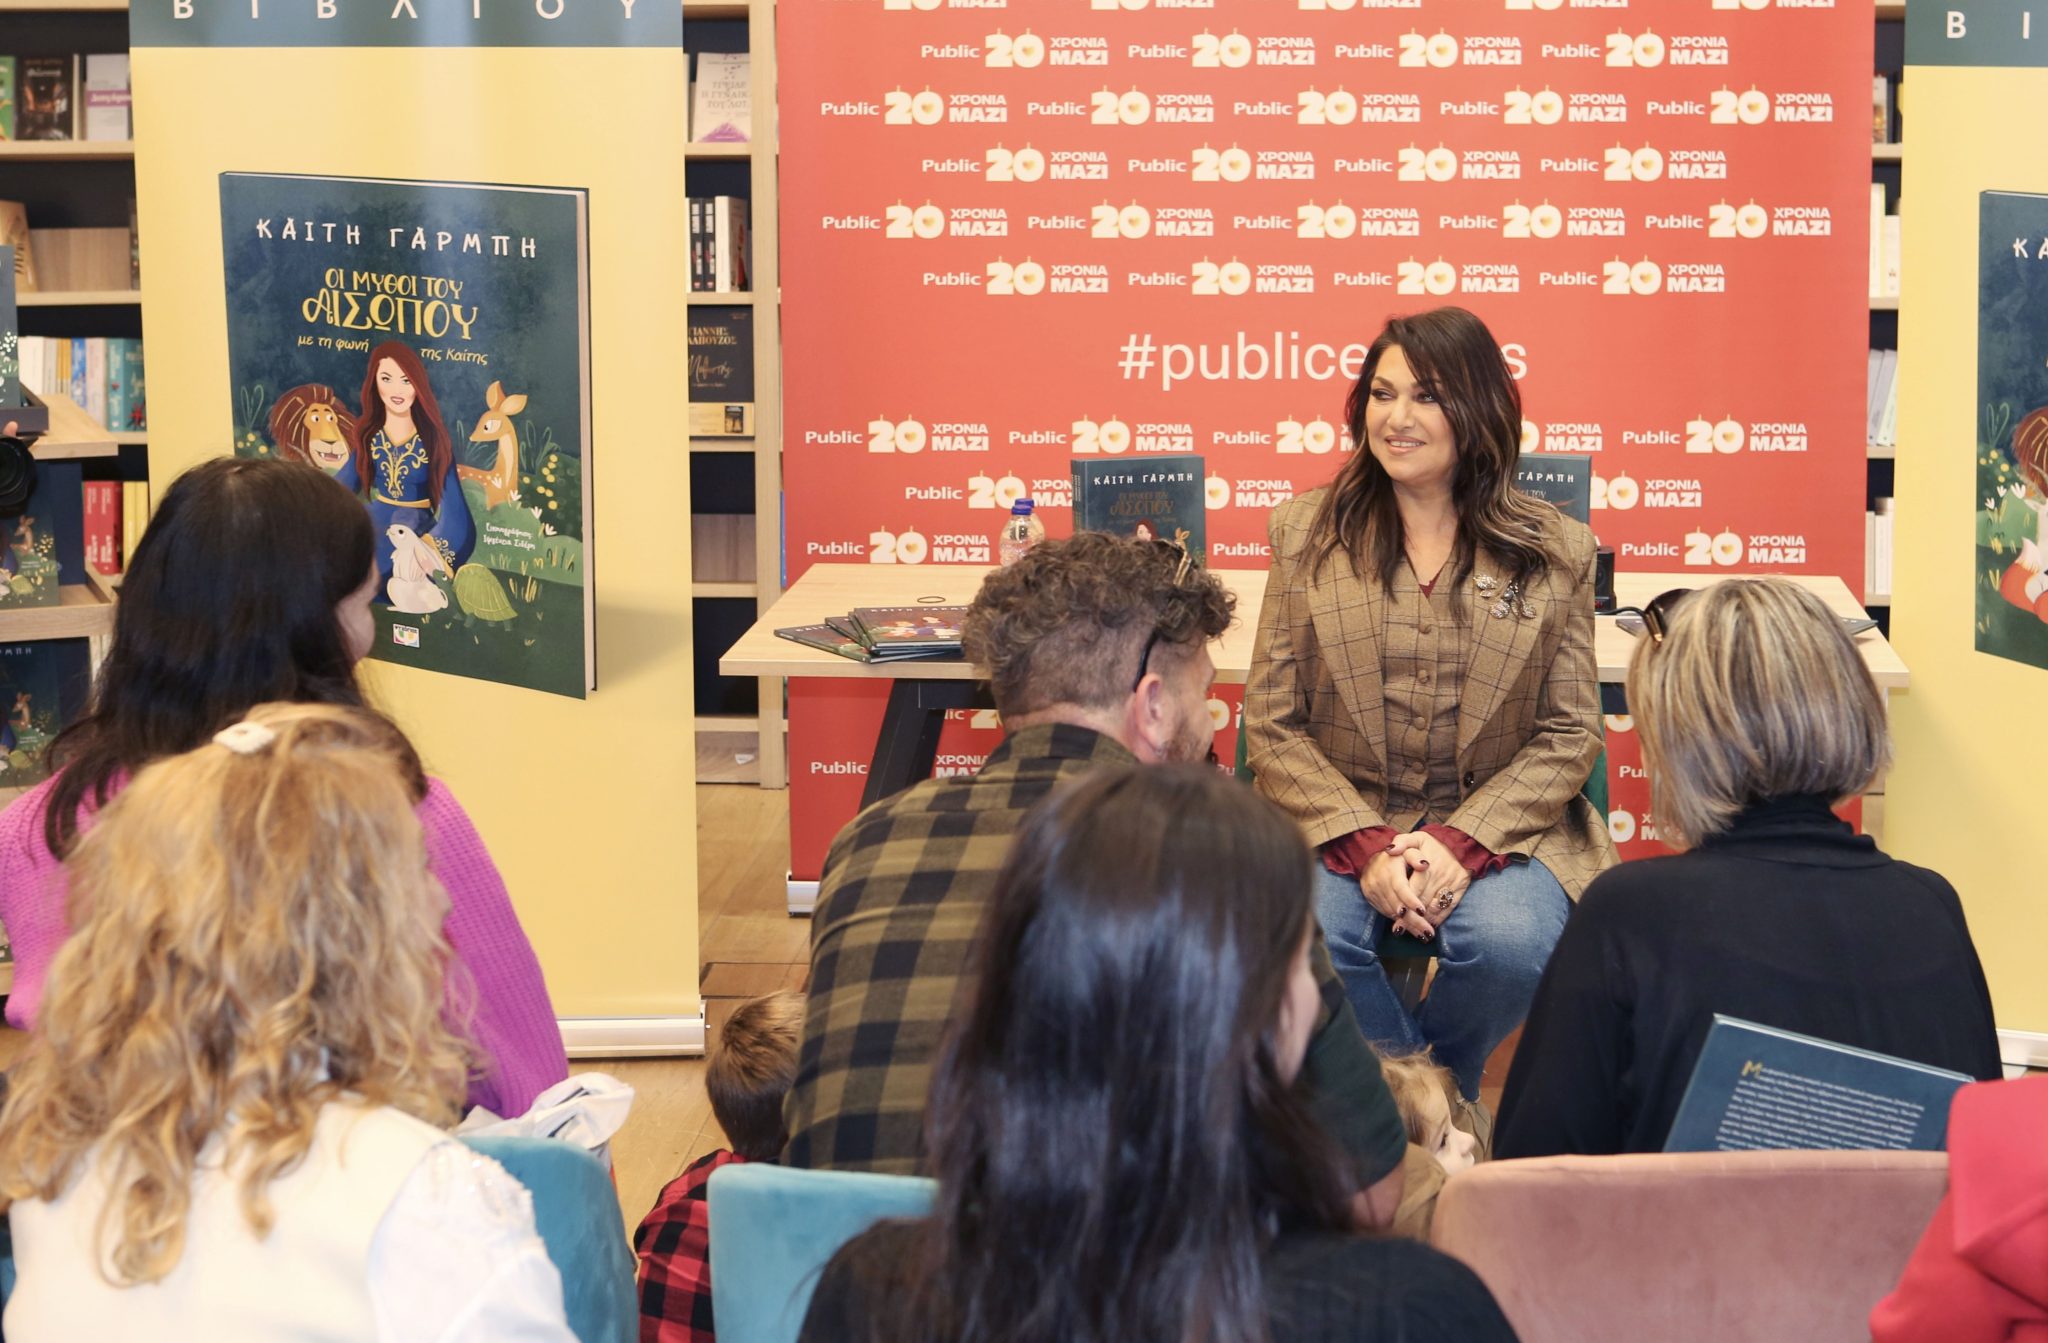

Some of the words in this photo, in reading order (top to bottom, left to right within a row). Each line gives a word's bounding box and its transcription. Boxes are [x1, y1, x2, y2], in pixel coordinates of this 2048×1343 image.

[1050, 37, 1109, 49] ΧΡΟΝΙΑ
[1256, 36, 1316, 48] ΧΡΟΝΙΑ
[1464, 36, 1522, 49] ΧΡΟΝΙΑ
[1671, 37, 1729, 49] ΧΡΟΝΙΑ
[921, 45, 979, 58] Public
[984, 33, 1045, 68] 20
[1049, 50, 1109, 65] ΜΑΖΙ
[1128, 44, 1186, 59] Public
[1192, 33, 1252, 68] 20
[1256, 50, 1315, 65] ΜΑΖΙ
[1335, 44, 1393, 58] Public
[1399, 33, 1459, 68] 20
[1463, 50, 1522, 65] ΜΑΖΙ
[1542, 44, 1600, 58] Public
[1605, 33, 1665, 67] 20
[1670, 50, 1728, 64] ΜΑΖΙ
[949, 95, 1008, 105] ΧΡΟΝΙΑ
[1156, 94, 1215, 106] ΧΡΟΝΙΑ
[1362, 94, 1421, 106] ΧΡΟΝΙΑ
[1568, 93, 1627, 105] ΧΡΟΝΙΑ
[1775, 94, 1833, 104] ΧΡΟΝΙΑ
[821, 102, 879, 115] Public
[885, 90, 944, 125] 20
[1027, 101, 1085, 115] Public
[1091, 90, 1151, 125] 20
[1155, 107, 1215, 122] ΜΑΖΙ
[1234, 101, 1292, 115] Public
[1297, 90, 1358, 125] 20
[1362, 107, 1421, 122] ΜΑΖΙ
[1440, 101, 1498, 115] Public
[1504, 90, 1564, 125] 20
[1568, 107, 1627, 122] ΜΑΖΙ
[1647, 101, 1704, 115] Public
[1710, 90, 1770, 124] 20
[1775, 107, 1833, 122] ΜΑΖΙ
[949, 107, 1008, 123] ΜΑΖΙ
[922, 159, 980, 172] Public
[986, 148, 1045, 182] 20
[1050, 151, 1108, 164] ΧΡΟΝΙΑ
[1128, 159, 1186, 172] Public
[1191, 148, 1252, 182] 20
[1256, 151, 1315, 164] ΧΡΟΝΙΑ
[1334, 159, 1392, 172] Public
[1397, 148, 1458, 182] 20
[1463, 151, 1521, 164] ΧΡΟΝΙΑ
[1540, 159, 1598, 172] Public
[1604, 148, 1663, 181] 20
[1669, 151, 1726, 164] ΧΡΟΝΙΑ
[1050, 164, 1109, 179] ΜΑΖΙ
[1256, 164, 1315, 179] ΜΑΖΙ
[1462, 164, 1521, 179] ΜΑΖΙ
[1668, 164, 1726, 179] ΜΑΖΙ
[950, 208, 1008, 220] ΧΡΟΝΙΑ
[1155, 208, 1215, 219] ΧΡΟΝΙΑ
[1361, 208, 1420, 219] ΧΡΟΝΙΑ
[1440, 215, 1497, 228] Public
[1503, 204, 1562, 238] 20
[1568, 208, 1625, 220] ΧΡΟΝΙΑ
[1645, 215, 1702, 228] Public
[1708, 204, 1768, 238] 20
[1774, 208, 1831, 220] ΧΡΟΝΙΑ
[823, 216, 880, 228] Public
[886, 204, 945, 239] 20
[950, 221, 1008, 236] ΜΑΖΙ
[1028, 216, 1085, 229] Public
[1091, 204, 1151, 239] 20
[1155, 221, 1214, 236] ΜΑΖΙ
[1234, 216, 1291, 229] Public
[1297, 204, 1357, 239] 20
[1361, 221, 1420, 237] ΜΑΖΙ
[1567, 221, 1625, 236] ΜΑΖΙ
[1773, 221, 1831, 235] ΜΑΖΙ
[256, 217, 361, 245] ΚΑΙΤΗ
[389, 226, 537, 259] ΓΑΡΜΠΗ
[923, 272, 980, 285] Public
[986, 261, 1046, 295] 20
[1050, 265, 1109, 276] ΧΡΟΝΙΑ
[1256, 265, 1314, 277] ΧΡΟΝΙΑ
[1461, 265, 1520, 277] ΧΡΟΝΙΑ
[1539, 272, 1597, 285] Public
[1603, 261, 1662, 295] 20
[1668, 264, 1725, 277] ΧΡΟΝΙΑ
[325, 267, 345, 289] ΟΙ
[352, 271, 418, 297] ΜΥΘΟΙ
[421, 276, 463, 300] ΤΟΥ
[1050, 278, 1109, 293] ΜΑΖΙ
[1128, 272, 1185, 285] Public
[1192, 261, 1252, 296] 20
[1256, 278, 1314, 293] ΜΑΖΙ
[1334, 272, 1392, 286] Public
[1397, 261, 1457, 296] 20
[1461, 278, 1520, 292] ΜΑΖΙ
[1667, 278, 1725, 292] ΜΑΖΙ
[302, 287, 479, 340] ΑΙΣΩΠΟΥ
[1118, 332, 1527, 391] #publices
[806, 431, 861, 443] Public
[868, 420, 926, 453] 20
[932, 424, 989, 434] ΧΡΟΝΙΑ
[1009, 431, 1065, 444] Public
[1072, 420, 1130, 453] 20
[1135, 424, 1193, 434] ΧΡΟΝΙΑ
[1545, 424, 1602, 434] ΧΡΟΝΙΑ
[1623, 431, 1680, 444] Public
[1686, 420, 1744, 453] 20
[1751, 424, 1807, 436] ΧΡΟΝΙΑ
[931, 436, 989, 451] ΜΑΖΙ
[1136, 437, 1193, 451] ΜΑΖΙ
[1213, 431, 1270, 444] Public
[1276, 420, 1335, 454] 20
[1545, 436, 1602, 451] ΜΑΖΙ
[1750, 436, 1807, 451] ΜΑΖΙ
[1032, 479, 1072, 490] ΧΡΟΝ
[1094, 475, 1133, 485] ΚΑΙΤΗ
[1143, 473, 1193, 483] ΓΑΡΜΠΗ
[1235, 480, 1292, 490] ΧΡΟΝΙΑ
[1518, 472, 1574, 483] ΓΑΡΜΠΗ
[1645, 480, 1701, 490] ΧΡΟΝΙΑ
[906, 487, 961, 499] Public
[968, 476, 1026, 509] 20
[1644, 492, 1701, 507] ΜΑΖΙ
[808, 542, 863, 554] Public
[869, 531, 928, 564] 20
[932, 535, 991, 545] ΧΡΟΝΙΑ
[1749, 536, 1806, 546] ΧΡΟΝΙΑ
[932, 548, 990, 562] ΜΑΖΙ
[1213, 543, 1270, 556] Public
[1622, 543, 1678, 555] Public
[1685, 531, 1743, 565] 20
[1748, 548, 1806, 563] ΜΑΖΙ
[810, 761, 867, 774] Public
